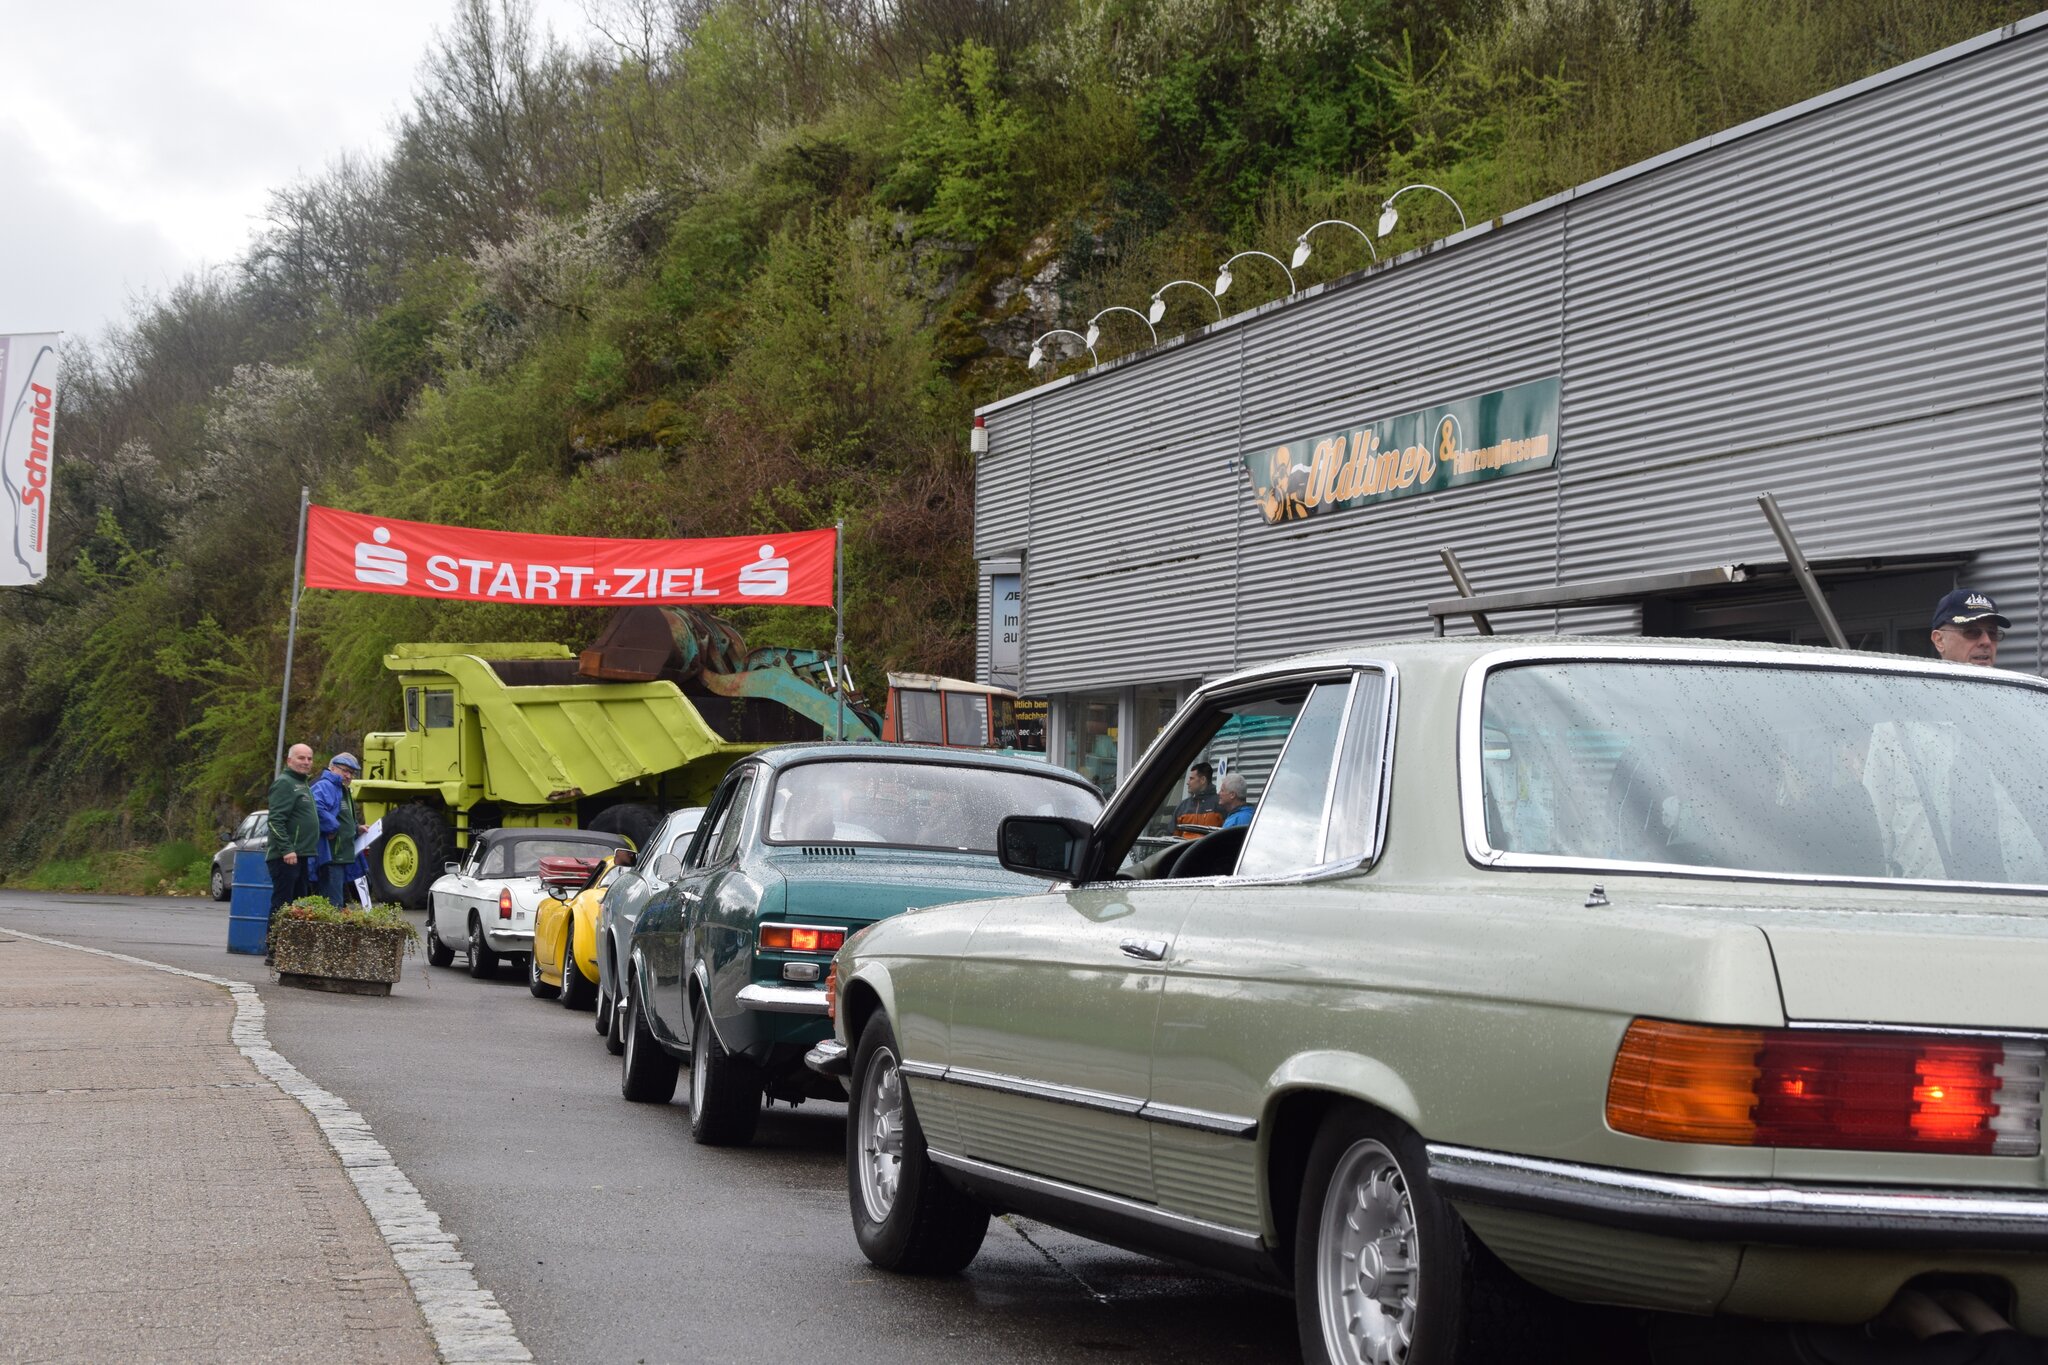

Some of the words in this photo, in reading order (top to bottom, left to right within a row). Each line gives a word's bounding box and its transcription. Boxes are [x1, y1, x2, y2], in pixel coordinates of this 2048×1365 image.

[22, 382, 52, 507] Schmid
[1304, 429, 1436, 508] Oldtimer
[29, 508, 37, 550] Autohaus
[1003, 632, 1020, 643] au
